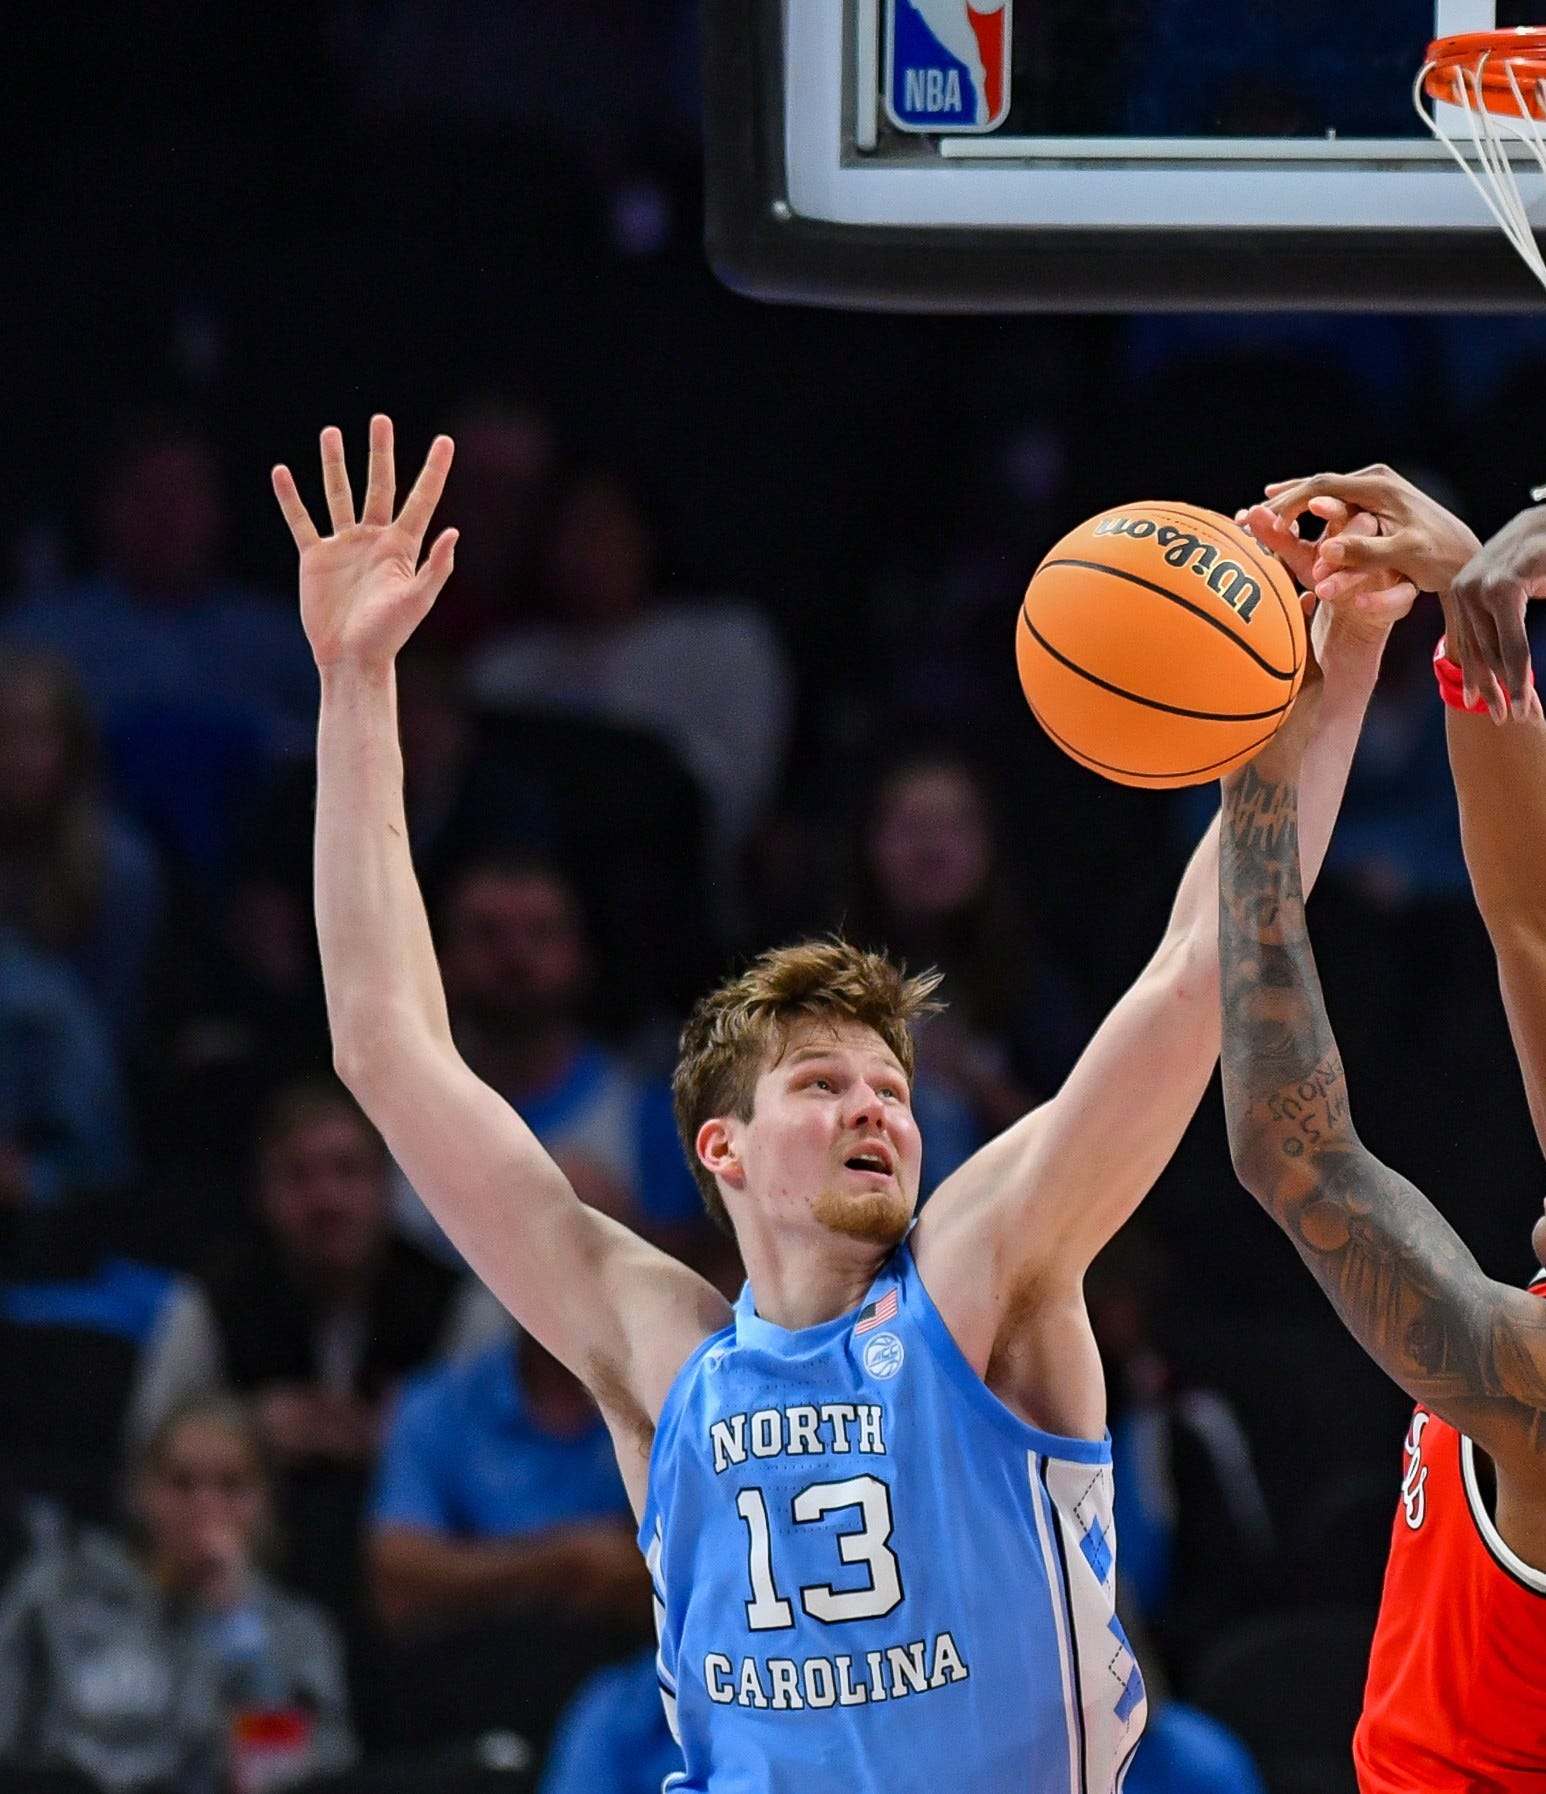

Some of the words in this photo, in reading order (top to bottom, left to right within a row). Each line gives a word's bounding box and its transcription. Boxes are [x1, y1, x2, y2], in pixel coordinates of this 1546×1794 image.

[905, 68, 963, 113] NBA
[1093, 515, 1263, 625] Wilson
[709, 1403, 887, 1474] NORTH
[735, 1474, 905, 1633] 13
[703, 1631, 970, 1712] CAROLINA
